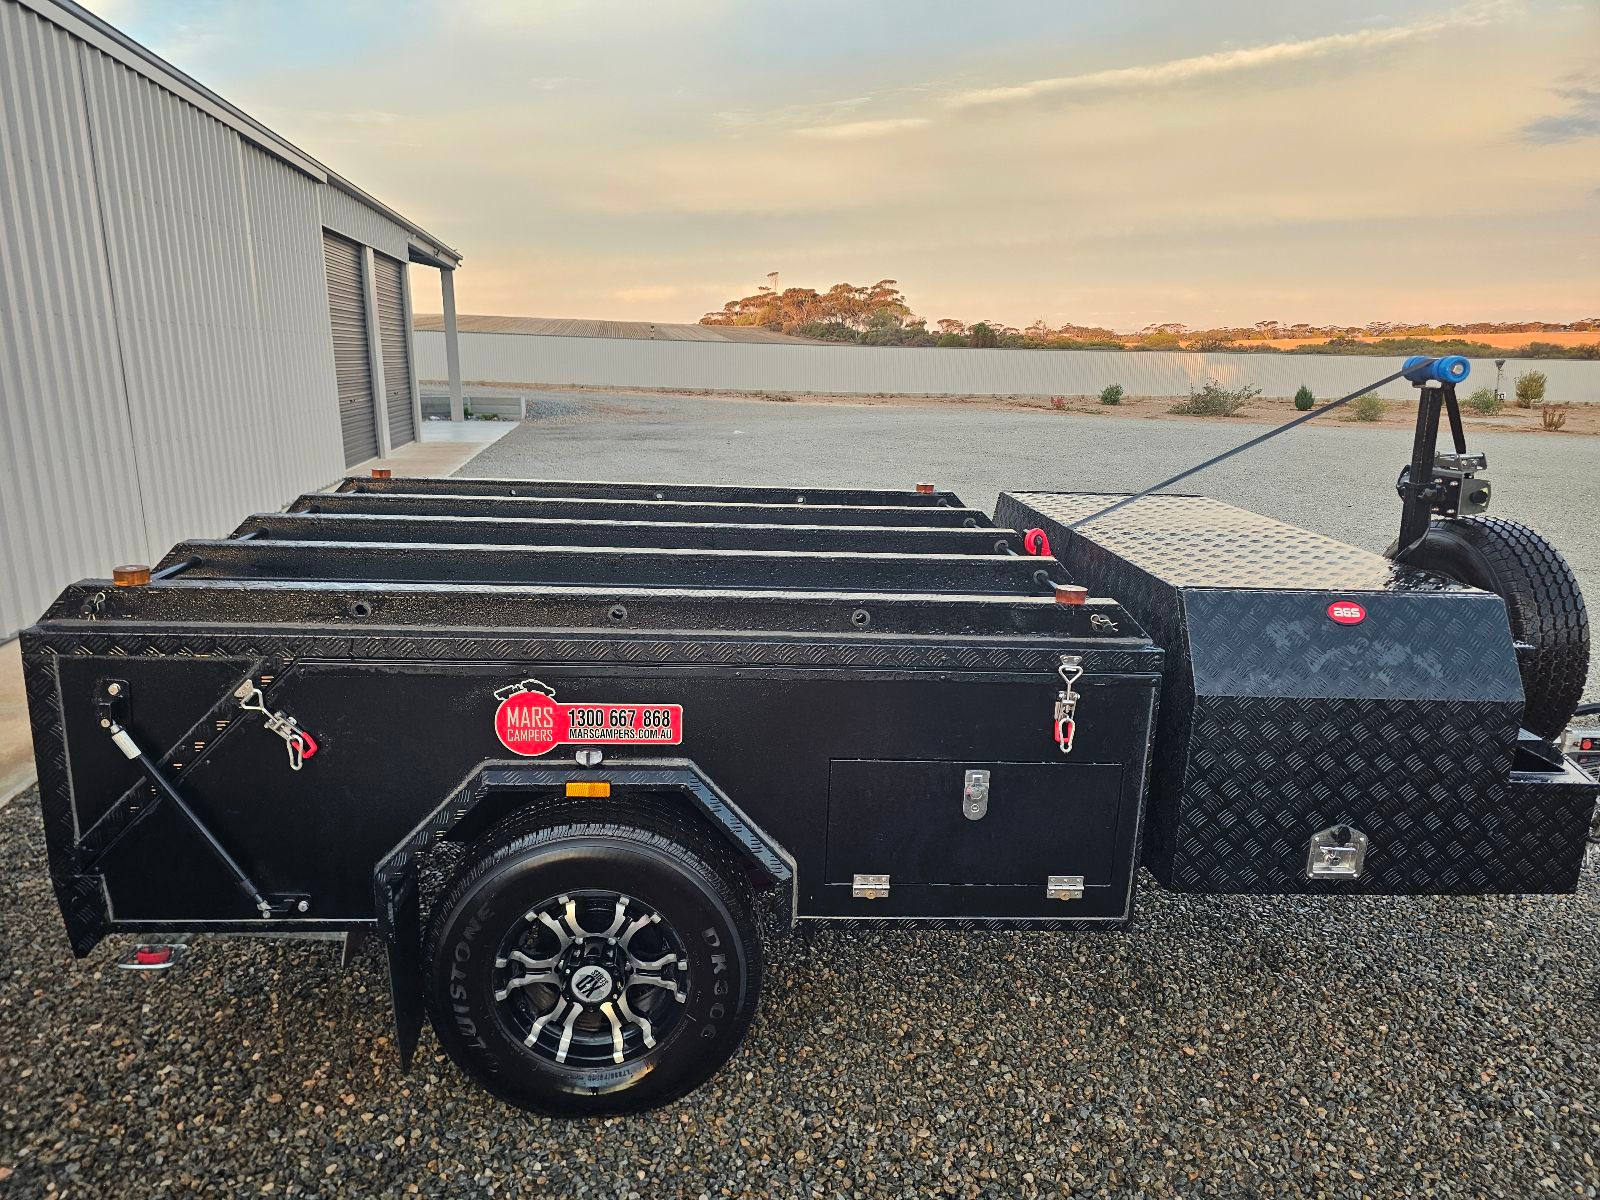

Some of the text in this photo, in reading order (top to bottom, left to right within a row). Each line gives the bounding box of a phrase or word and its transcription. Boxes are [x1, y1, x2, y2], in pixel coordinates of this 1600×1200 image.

[507, 706, 554, 728] MARS
[568, 709, 670, 727] 1300 667 868
[507, 729, 553, 742] CAMPERS
[569, 728, 672, 739] MARSCAMPERS.COM.AU
